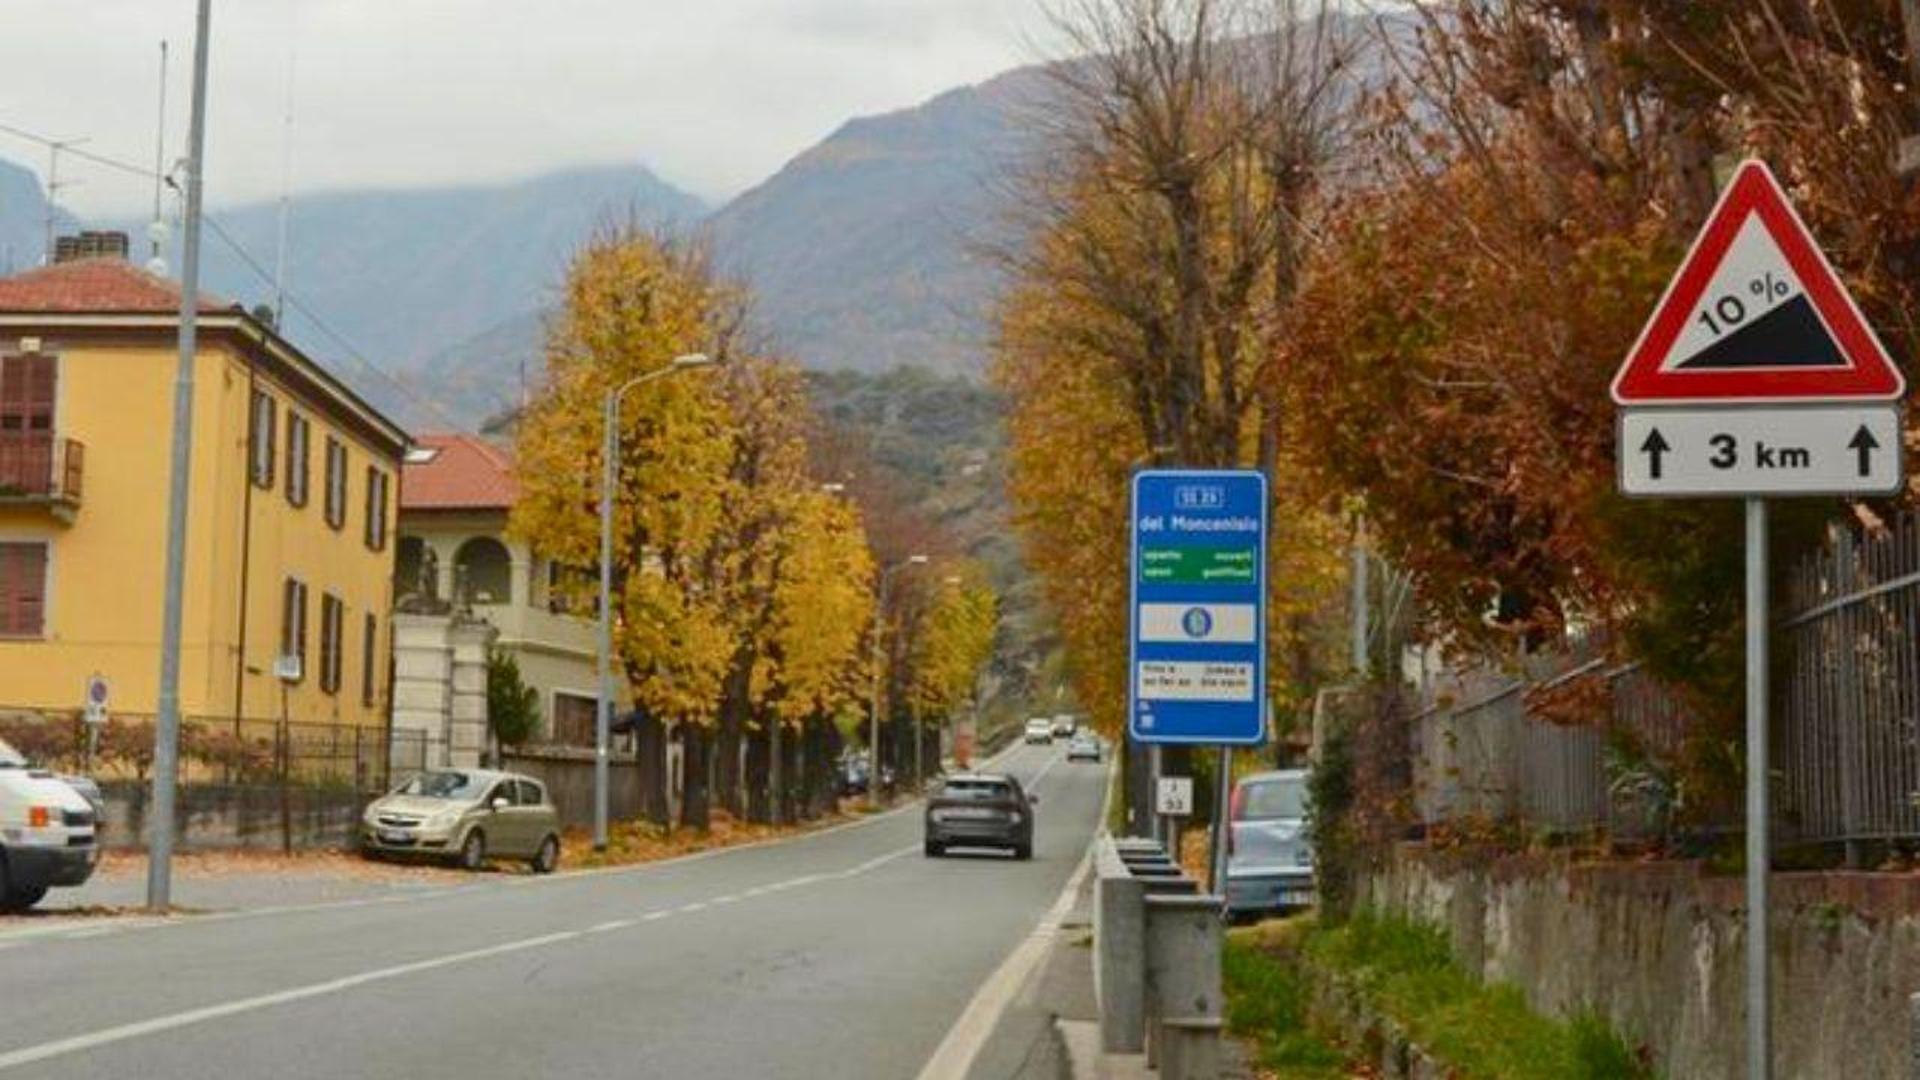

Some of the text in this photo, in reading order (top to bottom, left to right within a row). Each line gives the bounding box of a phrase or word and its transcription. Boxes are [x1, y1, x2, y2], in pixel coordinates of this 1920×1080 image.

[1698, 271, 1790, 335] 10 %
[1708, 433, 1810, 469] 3 km
